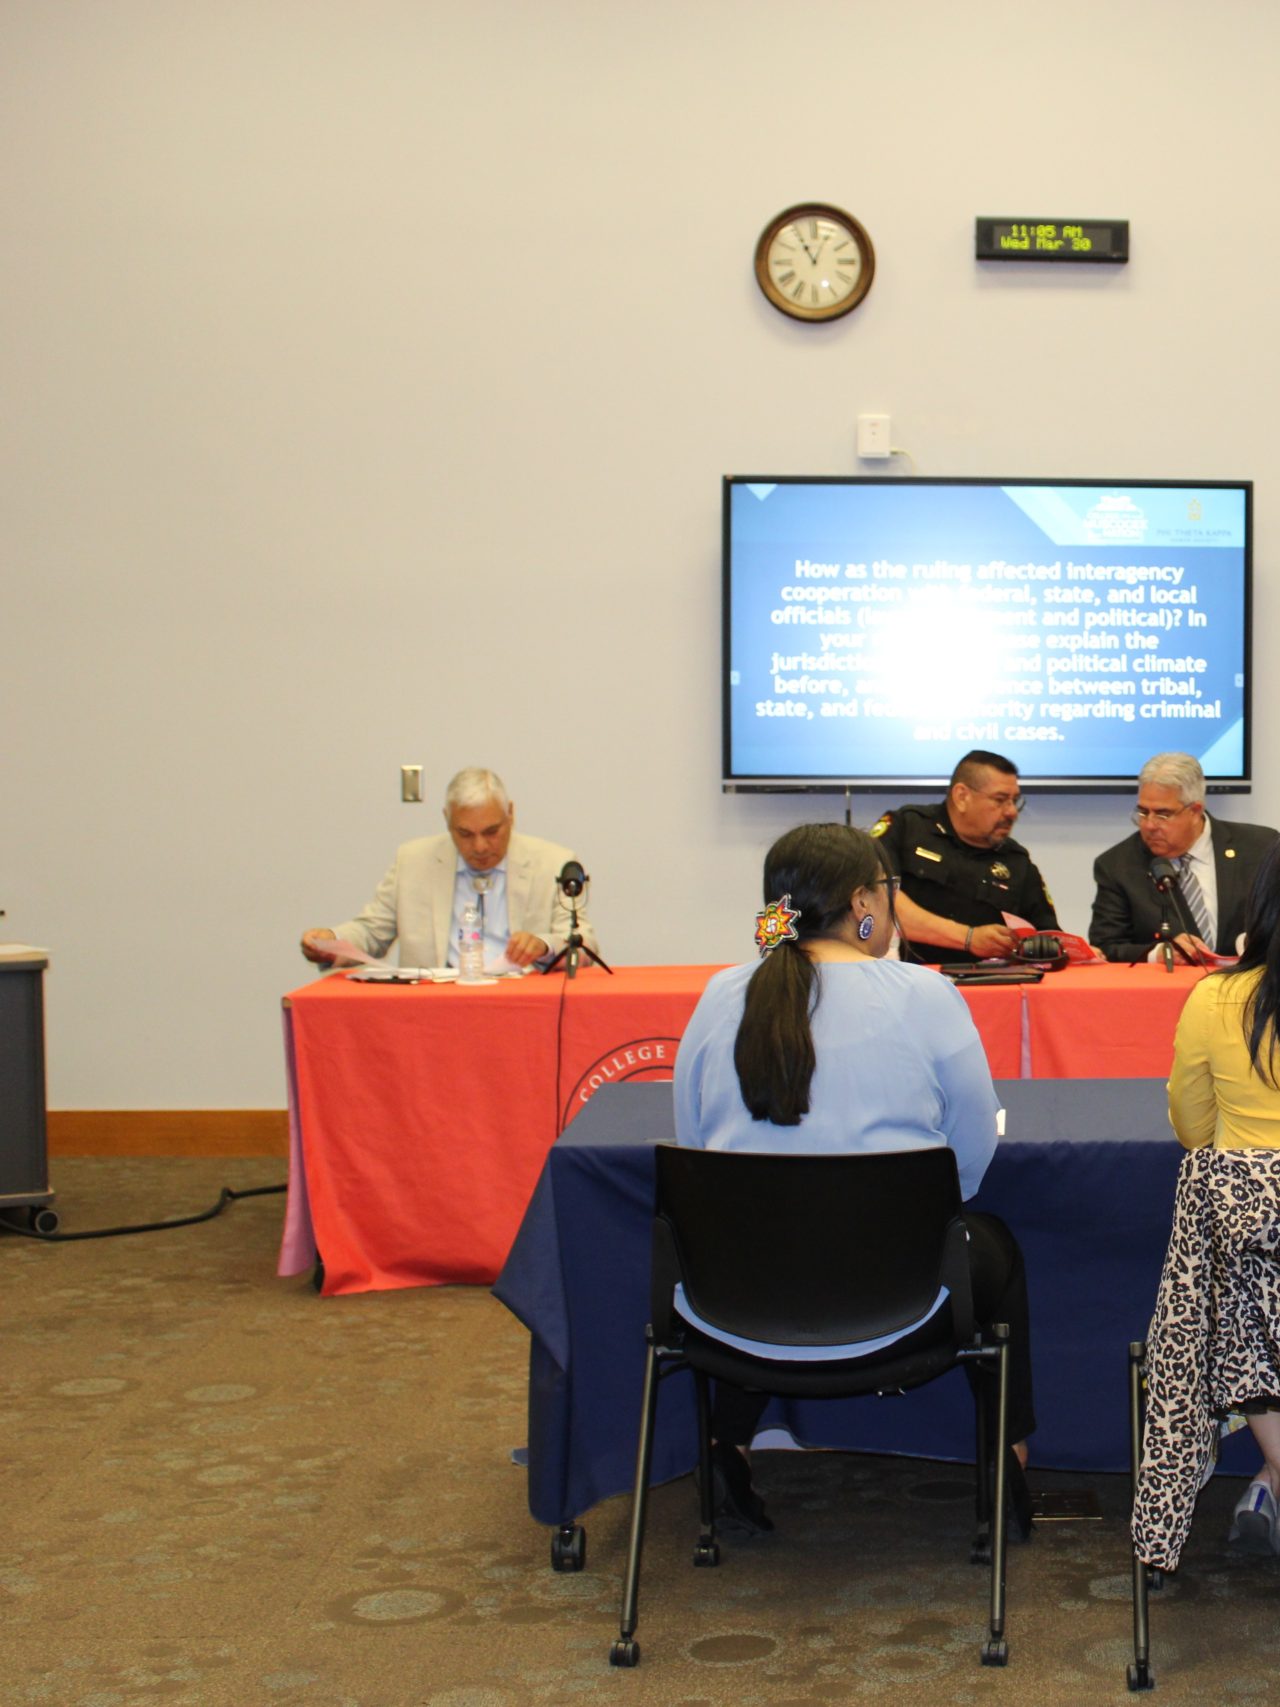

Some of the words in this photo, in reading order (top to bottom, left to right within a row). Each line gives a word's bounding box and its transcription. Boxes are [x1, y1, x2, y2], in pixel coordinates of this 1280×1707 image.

[1011, 224, 1056, 239] 11:05
[1063, 225, 1083, 239] AM
[1001, 236, 1030, 250] Wed
[1036, 238, 1064, 250] Mar
[1072, 237, 1092, 251] 30
[795, 560, 840, 578] How
[845, 564, 868, 578] as
[872, 560, 908, 579] the
[912, 561, 973, 583] ruling
[976, 561, 1062, 581] affected
[1066, 562, 1185, 585] interagency
[780, 585, 903, 605] cooperation
[1043, 585, 1101, 606] state,
[1107, 585, 1145, 603] and
[1151, 585, 1198, 604] local
[770, 605, 851, 625] officials
[1042, 608, 1080, 626] and
[1084, 608, 1183, 630] political)?
[1188, 608, 1208, 627] In
[820, 632, 866, 652] your
[1046, 630, 1120, 653] explain
[1124, 631, 1160, 649] the
[1004, 654, 1041, 672] and
[1046, 654, 1128, 676] political
[1132, 654, 1208, 673] climate
[774, 675, 849, 697] before,
[1048, 677, 1136, 695] between
[1141, 677, 1203, 698] tribal,
[755, 699, 815, 720] state,
[820, 699, 859, 717] and
[1040, 700, 1136, 722] regarding
[1140, 700, 1221, 718] criminal
[913, 721, 951, 741] and
[956, 722, 999, 741] civil
[1004, 725, 1065, 742] cases.
[580, 1045, 665, 1102] COLLEGE
